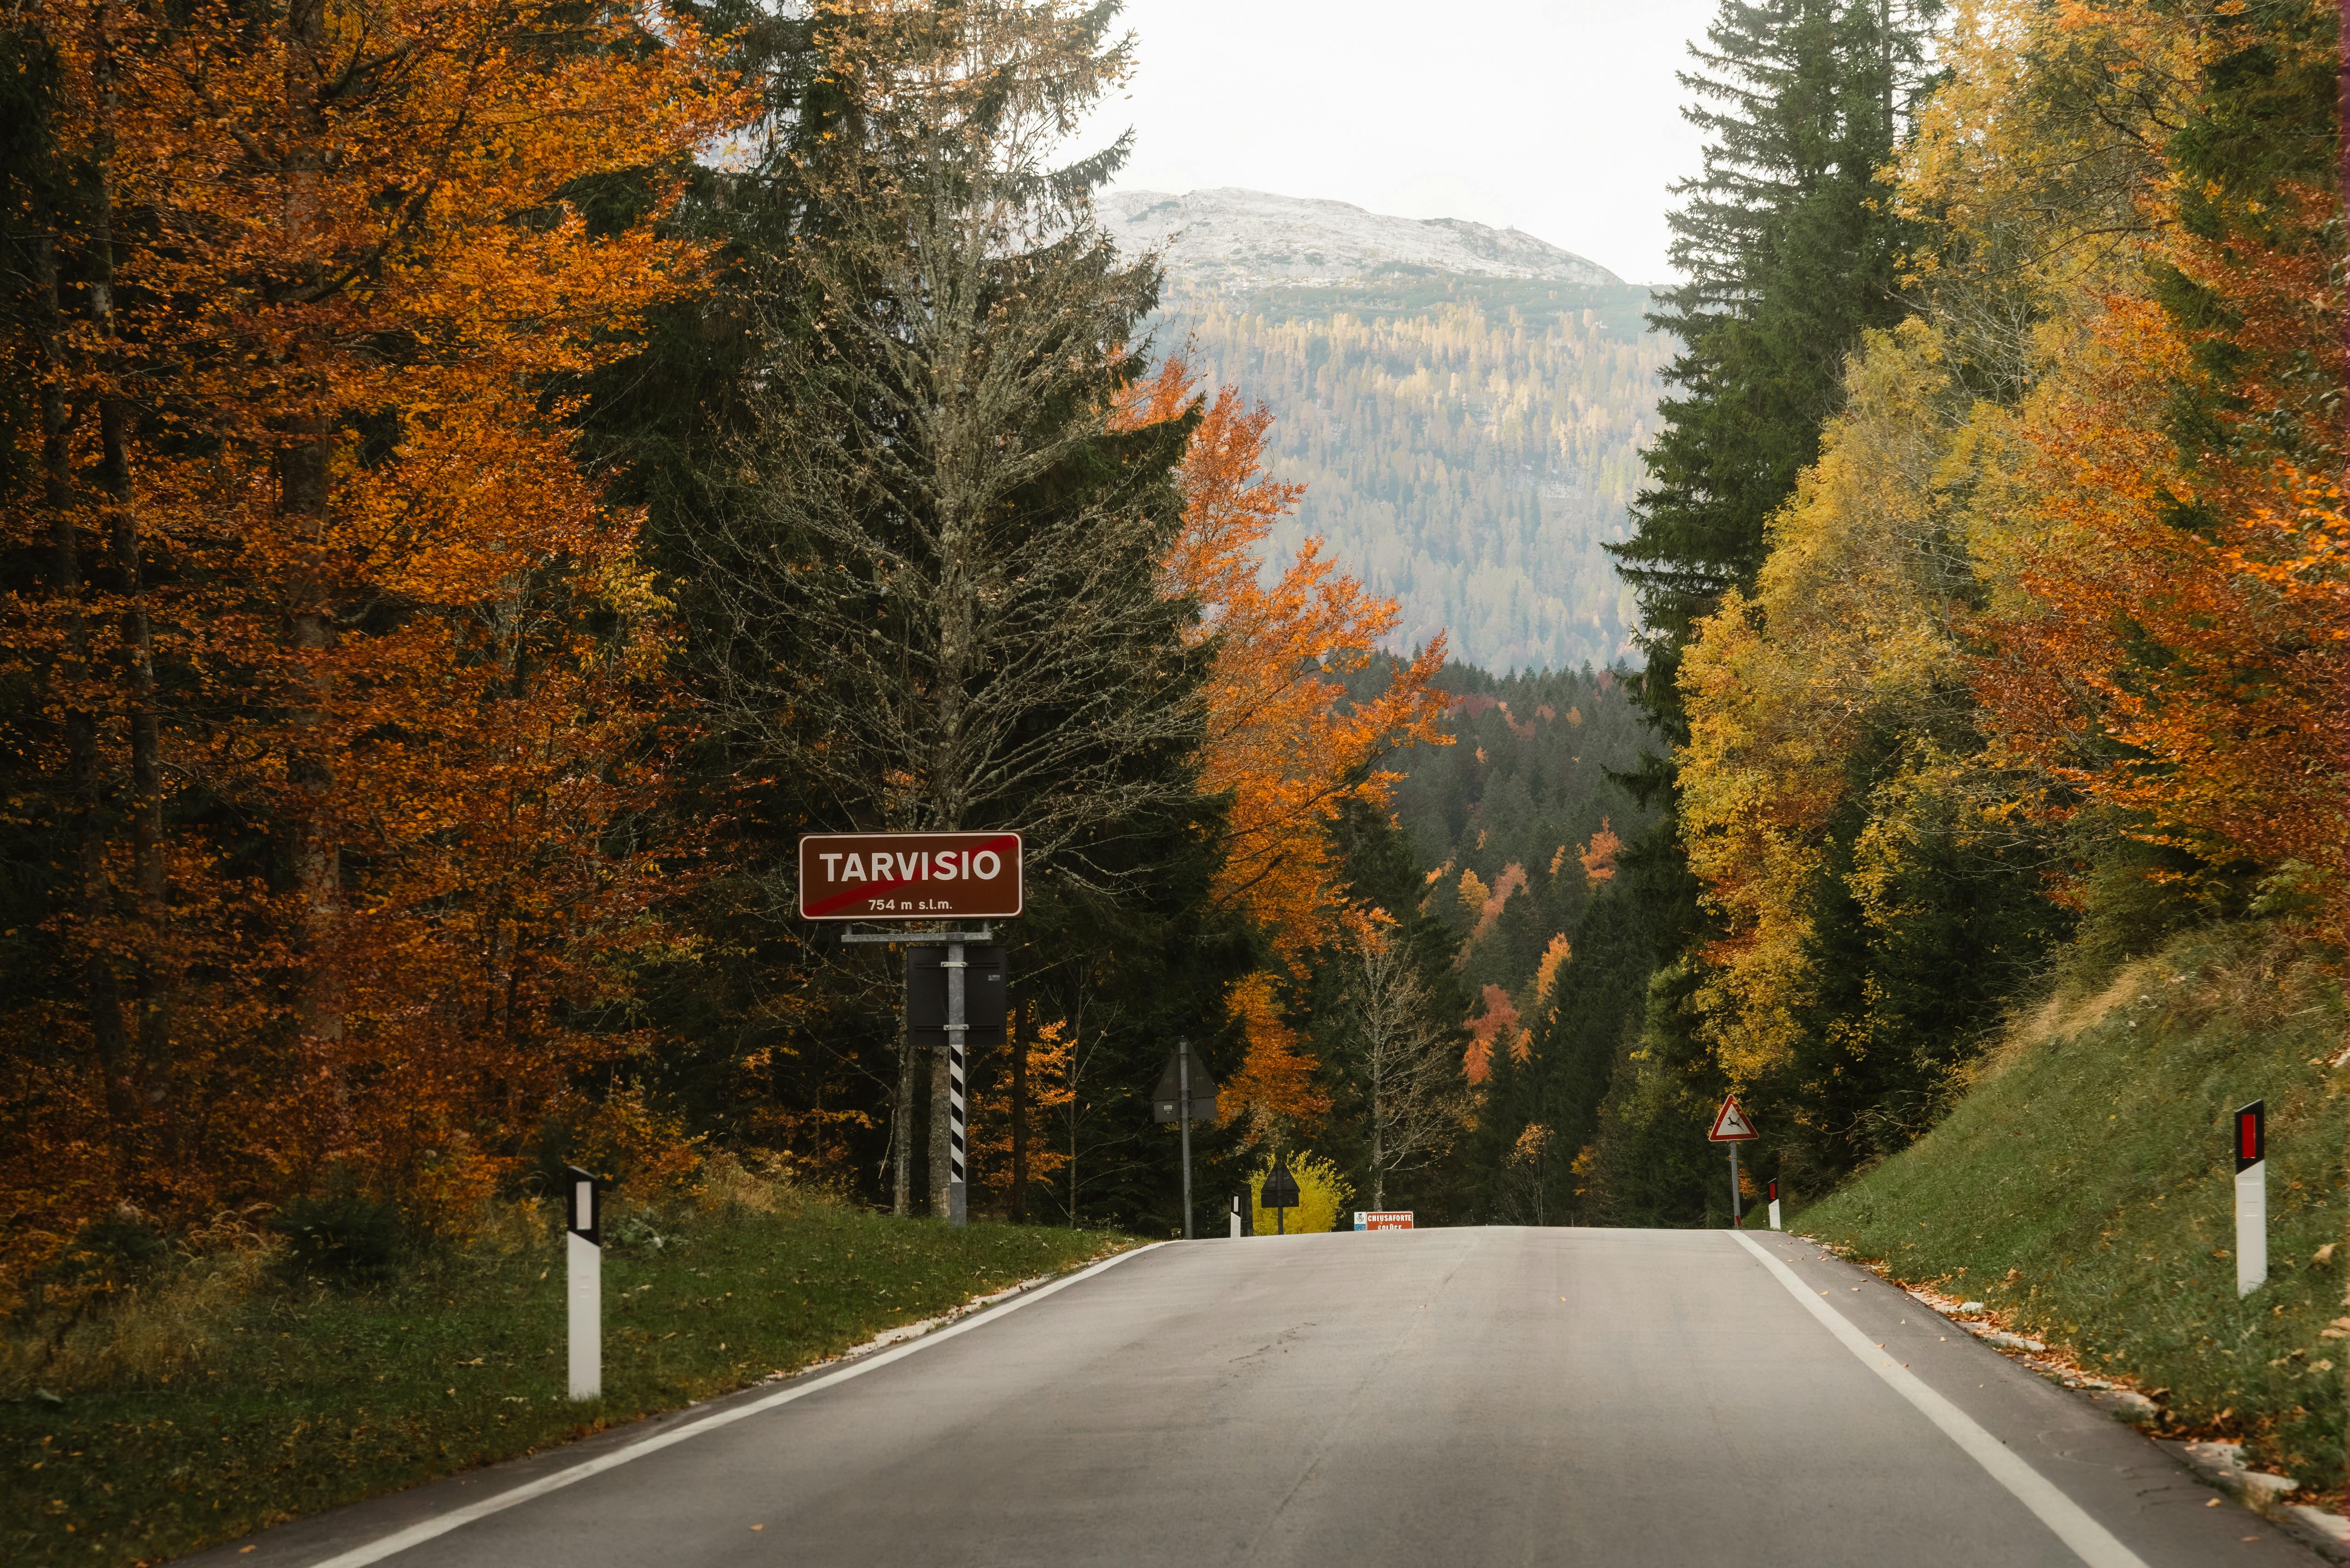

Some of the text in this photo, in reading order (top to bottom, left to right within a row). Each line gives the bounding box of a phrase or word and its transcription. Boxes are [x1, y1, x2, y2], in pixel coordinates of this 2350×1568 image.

[819, 851, 1000, 882] TARVISIO
[868, 899, 953, 911] 754 m s.l.m.
